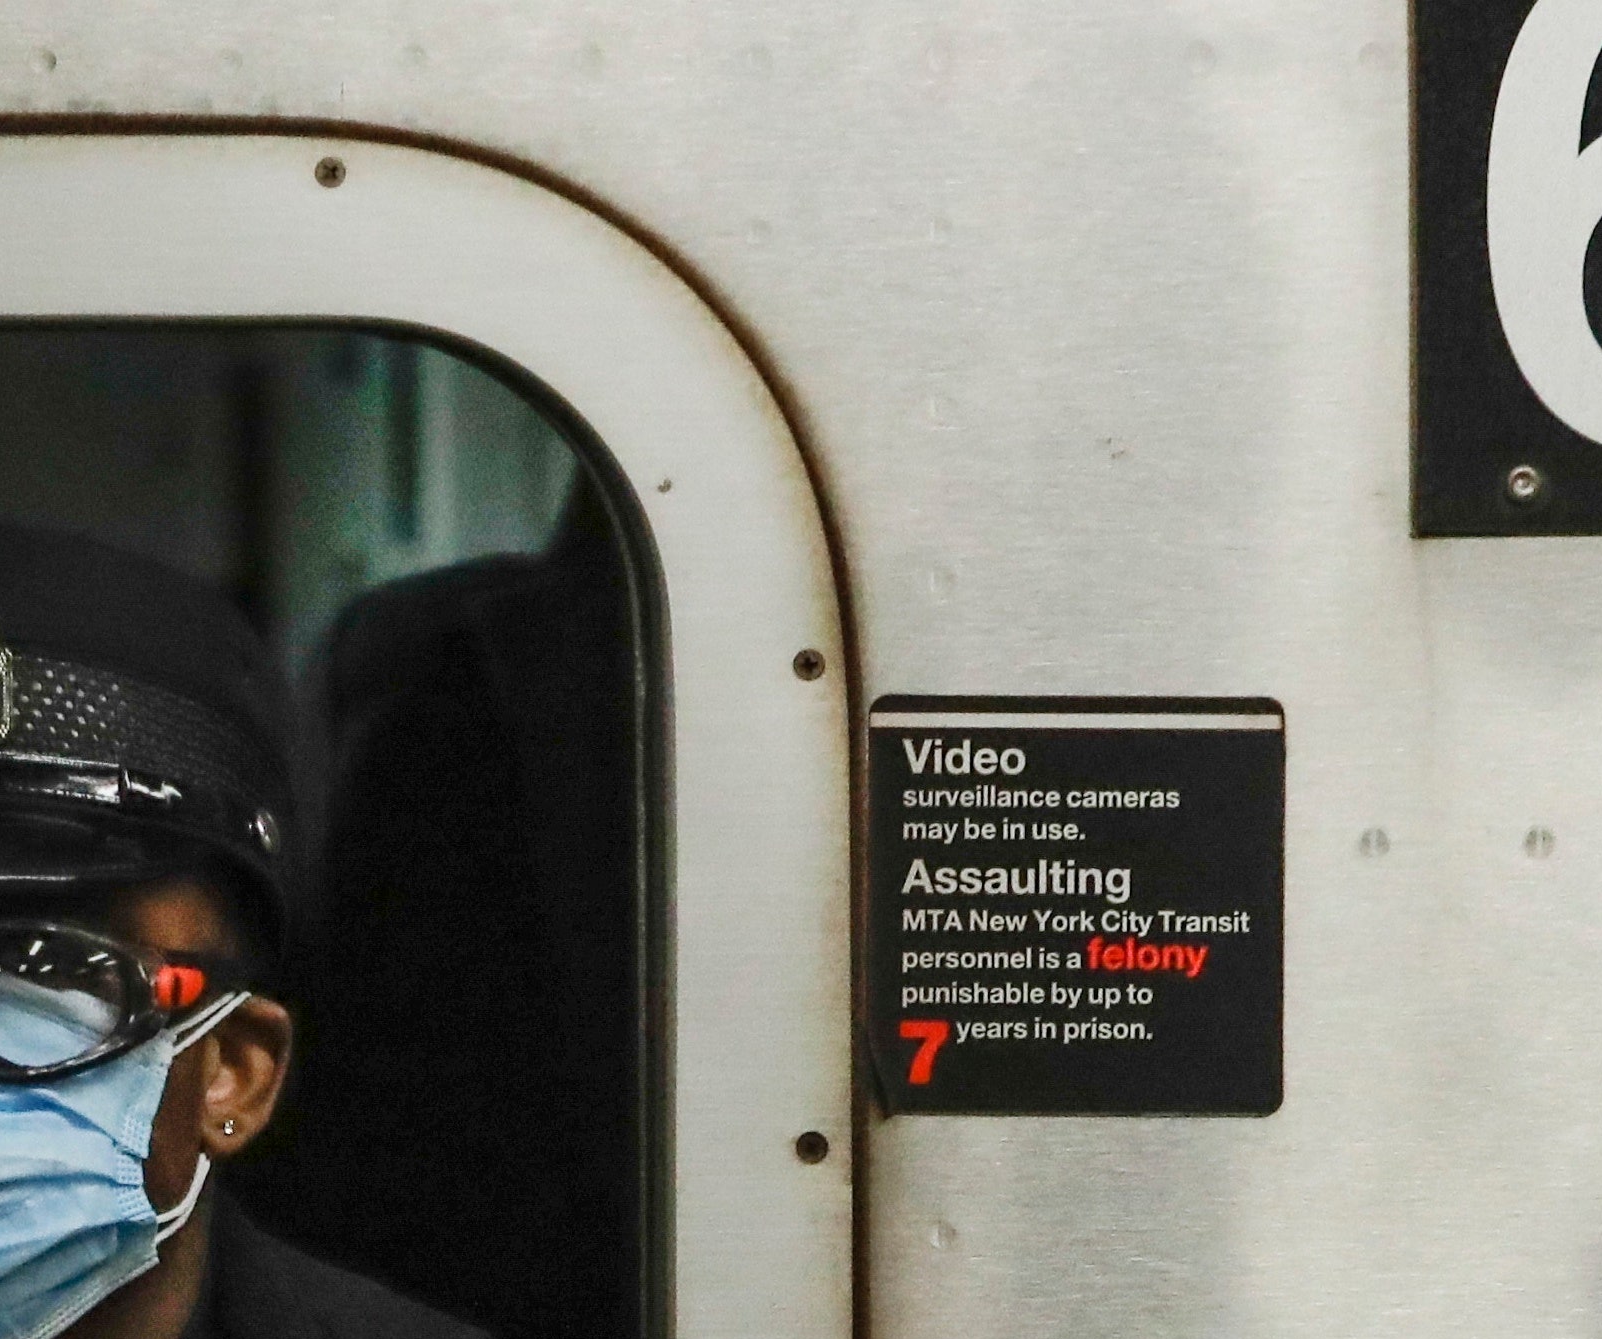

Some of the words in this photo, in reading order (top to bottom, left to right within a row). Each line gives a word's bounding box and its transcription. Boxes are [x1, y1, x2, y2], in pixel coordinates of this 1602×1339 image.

[902, 739, 1025, 775] Video
[903, 785, 1060, 808] surveillance
[1066, 791, 1180, 808] cameras
[903, 823, 958, 844] may
[964, 818, 996, 839] be
[1003, 817, 1025, 839] in
[1032, 823, 1085, 840] use.
[902, 859, 1130, 904] Assaulting
[903, 909, 963, 931] MTA
[970, 909, 1027, 931] New
[1033, 909, 1095, 932] York
[1101, 909, 1153, 937] City
[1158, 910, 1250, 933] Transit
[902, 947, 1032, 973] personnel
[1039, 948, 1060, 969] is
[1066, 952, 1081, 969] a
[1087, 934, 1208, 978] felony
[902, 981, 1045, 1008] punishable
[1051, 982, 1082, 1008] by
[1089, 988, 1121, 1009] up
[1126, 984, 1153, 1004] to
[900, 1020, 949, 1084] 7
[956, 1022, 1027, 1043] years
[1035, 1017, 1056, 1038] in
[1064, 1017, 1152, 1044] prison.
